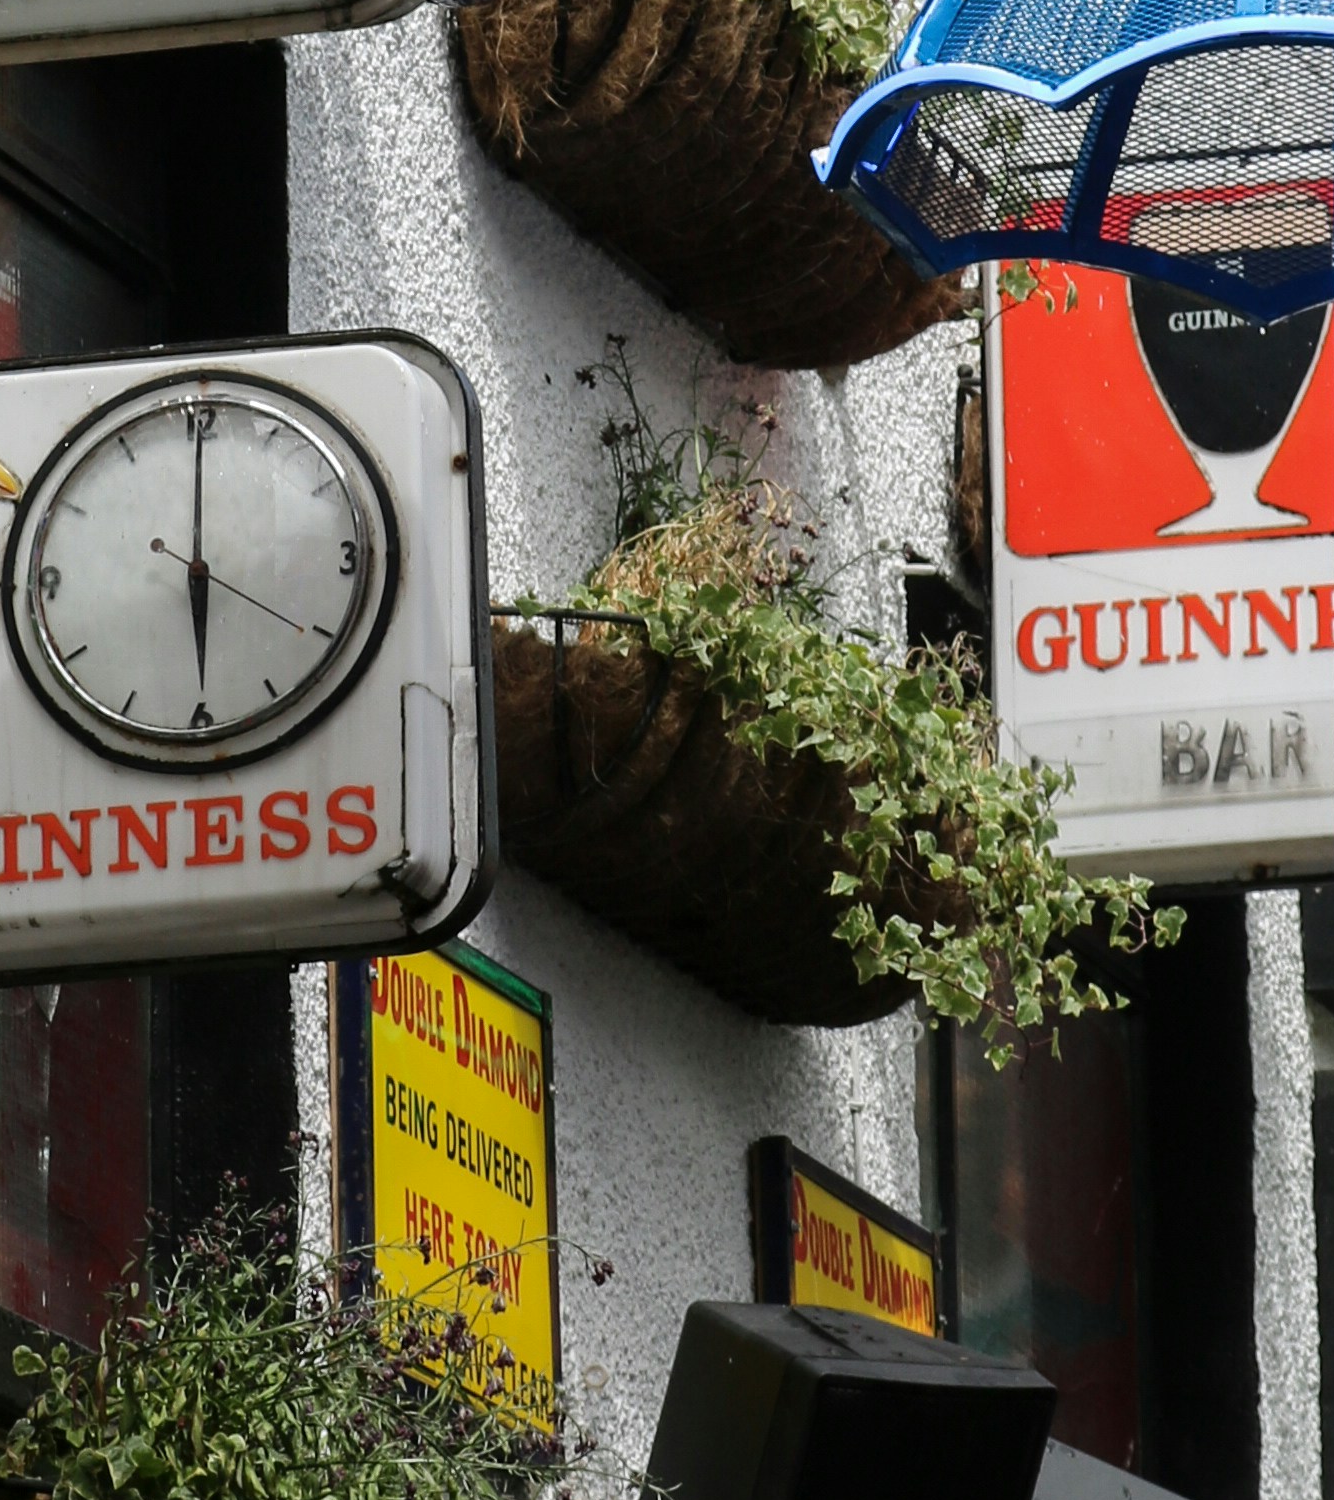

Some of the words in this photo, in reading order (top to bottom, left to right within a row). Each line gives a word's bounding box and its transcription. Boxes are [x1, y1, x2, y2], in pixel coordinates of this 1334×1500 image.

[39, 565, 62, 600] 9
[338, 540, 358, 576] 3
[190, 702, 214, 729] 6
[1160, 711, 1308, 785] BAR
[371, 952, 446, 1053] DOUBLE
[452, 974, 542, 1115] DIAMOND
[384, 1074, 439, 1151] BEING
[444, 1111, 534, 1209] DELIVERED
[405, 1187, 456, 1270] HERE
[463, 1221, 522, 1307] TODAY
[792, 1176, 855, 1293] DOUBLE
[857, 1216, 934, 1332] DIAMOND
